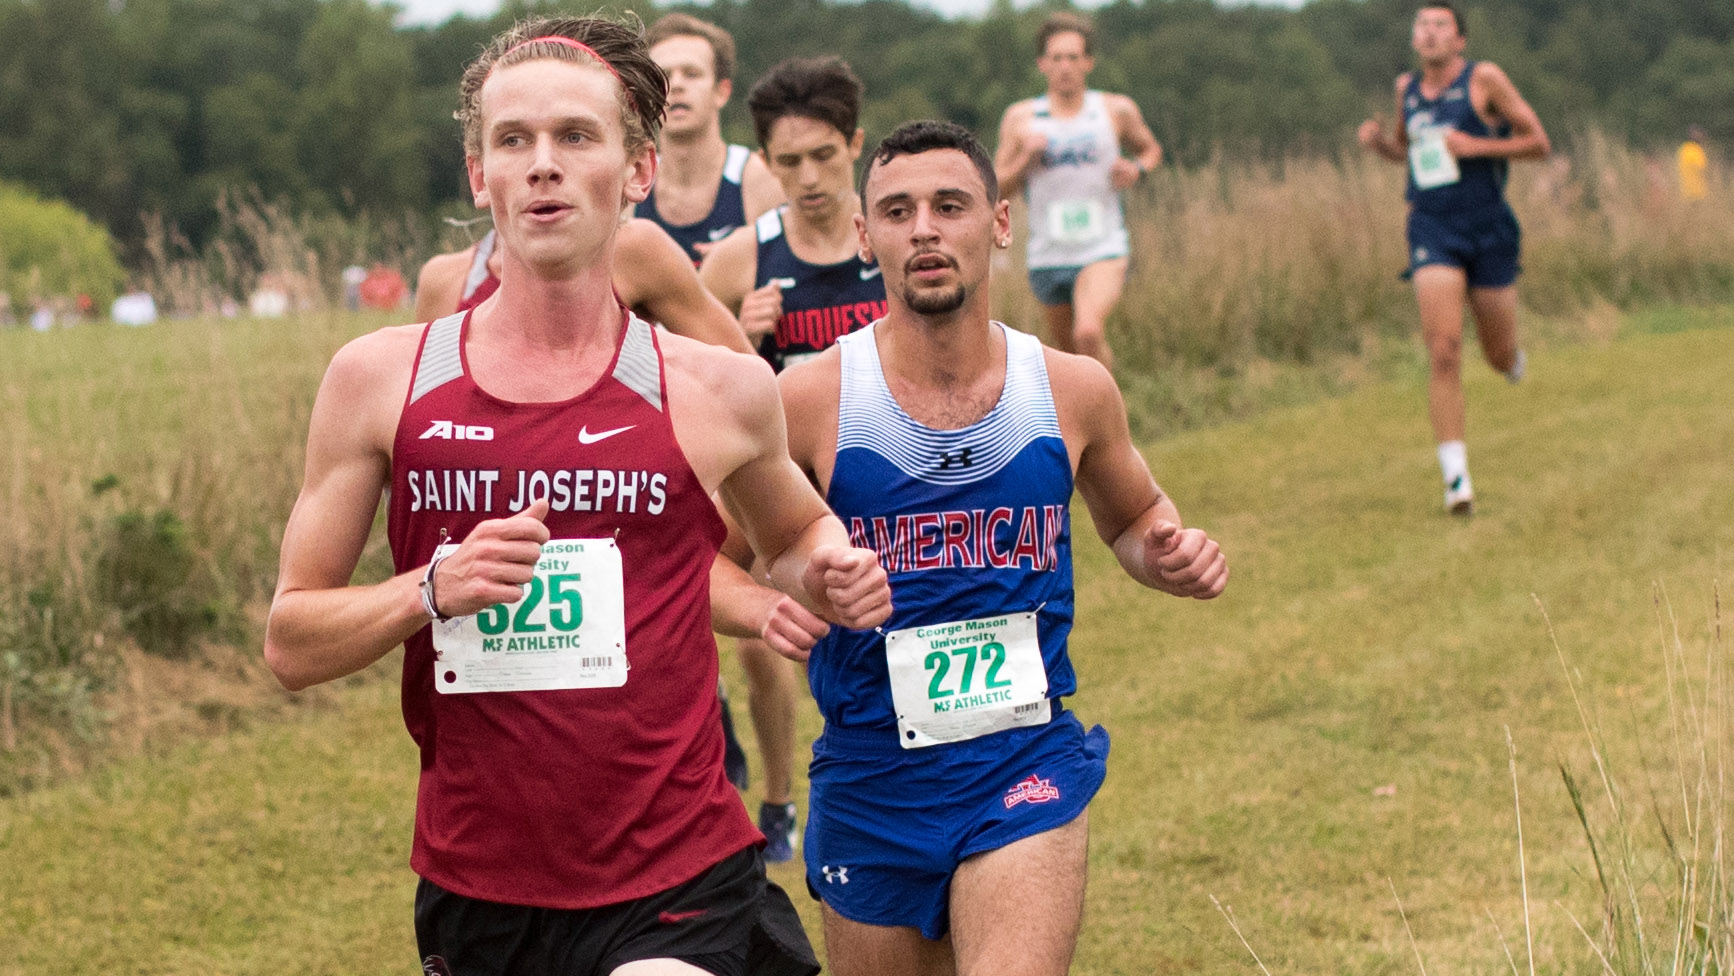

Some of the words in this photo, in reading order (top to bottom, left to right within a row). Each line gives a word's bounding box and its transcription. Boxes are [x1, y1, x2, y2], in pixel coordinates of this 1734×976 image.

[418, 420, 494, 441] A10
[408, 470, 499, 512] SAINT
[508, 469, 668, 515] JOSEPH'S
[850, 505, 1063, 572] AMERICAN
[916, 624, 962, 639] George
[965, 618, 1008, 631] Mason
[507, 635, 580, 651] ATHLETIC
[930, 632, 996, 650] University
[924, 642, 1012, 699] 272
[954, 689, 1012, 710] ATHLETIC
